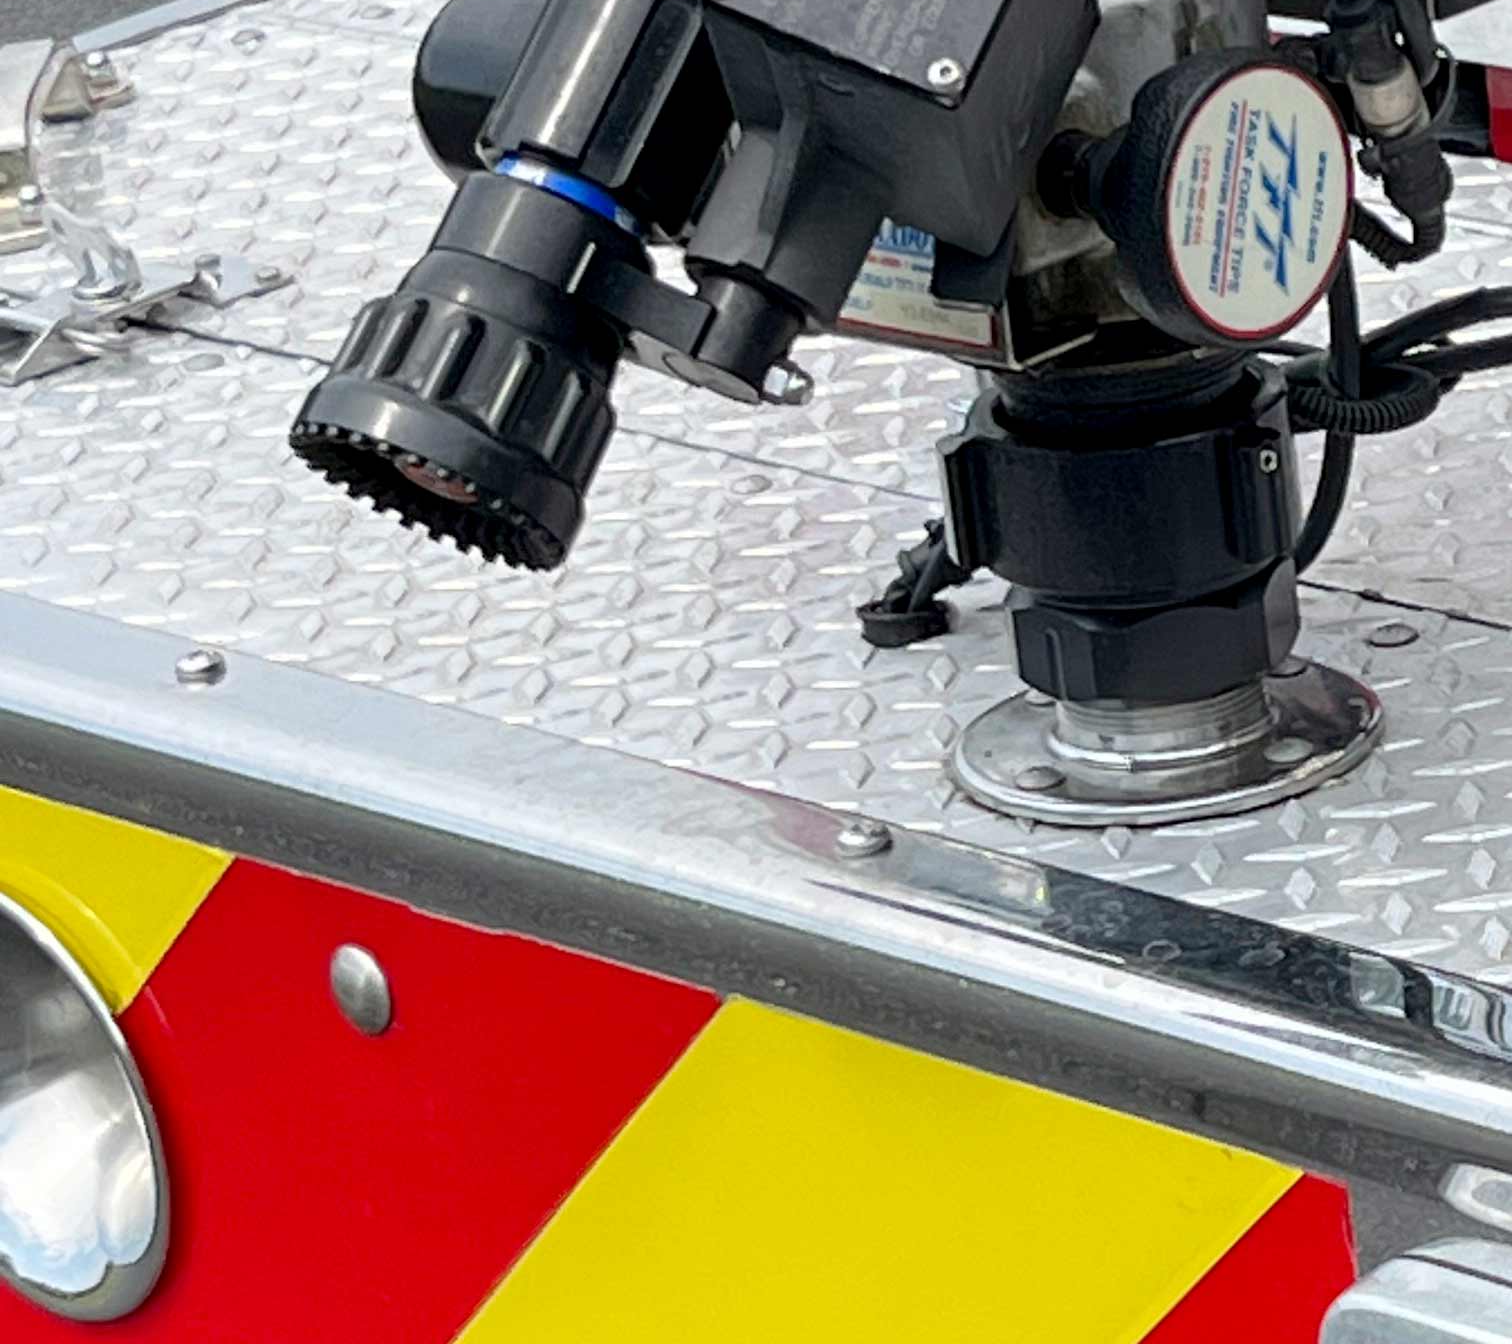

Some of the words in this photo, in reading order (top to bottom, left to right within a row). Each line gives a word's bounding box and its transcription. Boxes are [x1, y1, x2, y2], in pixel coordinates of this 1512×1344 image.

[1243, 108, 1261, 161] TASK
[1233, 166, 1253, 240] FORCE
[1227, 247, 1244, 294] TIPS
